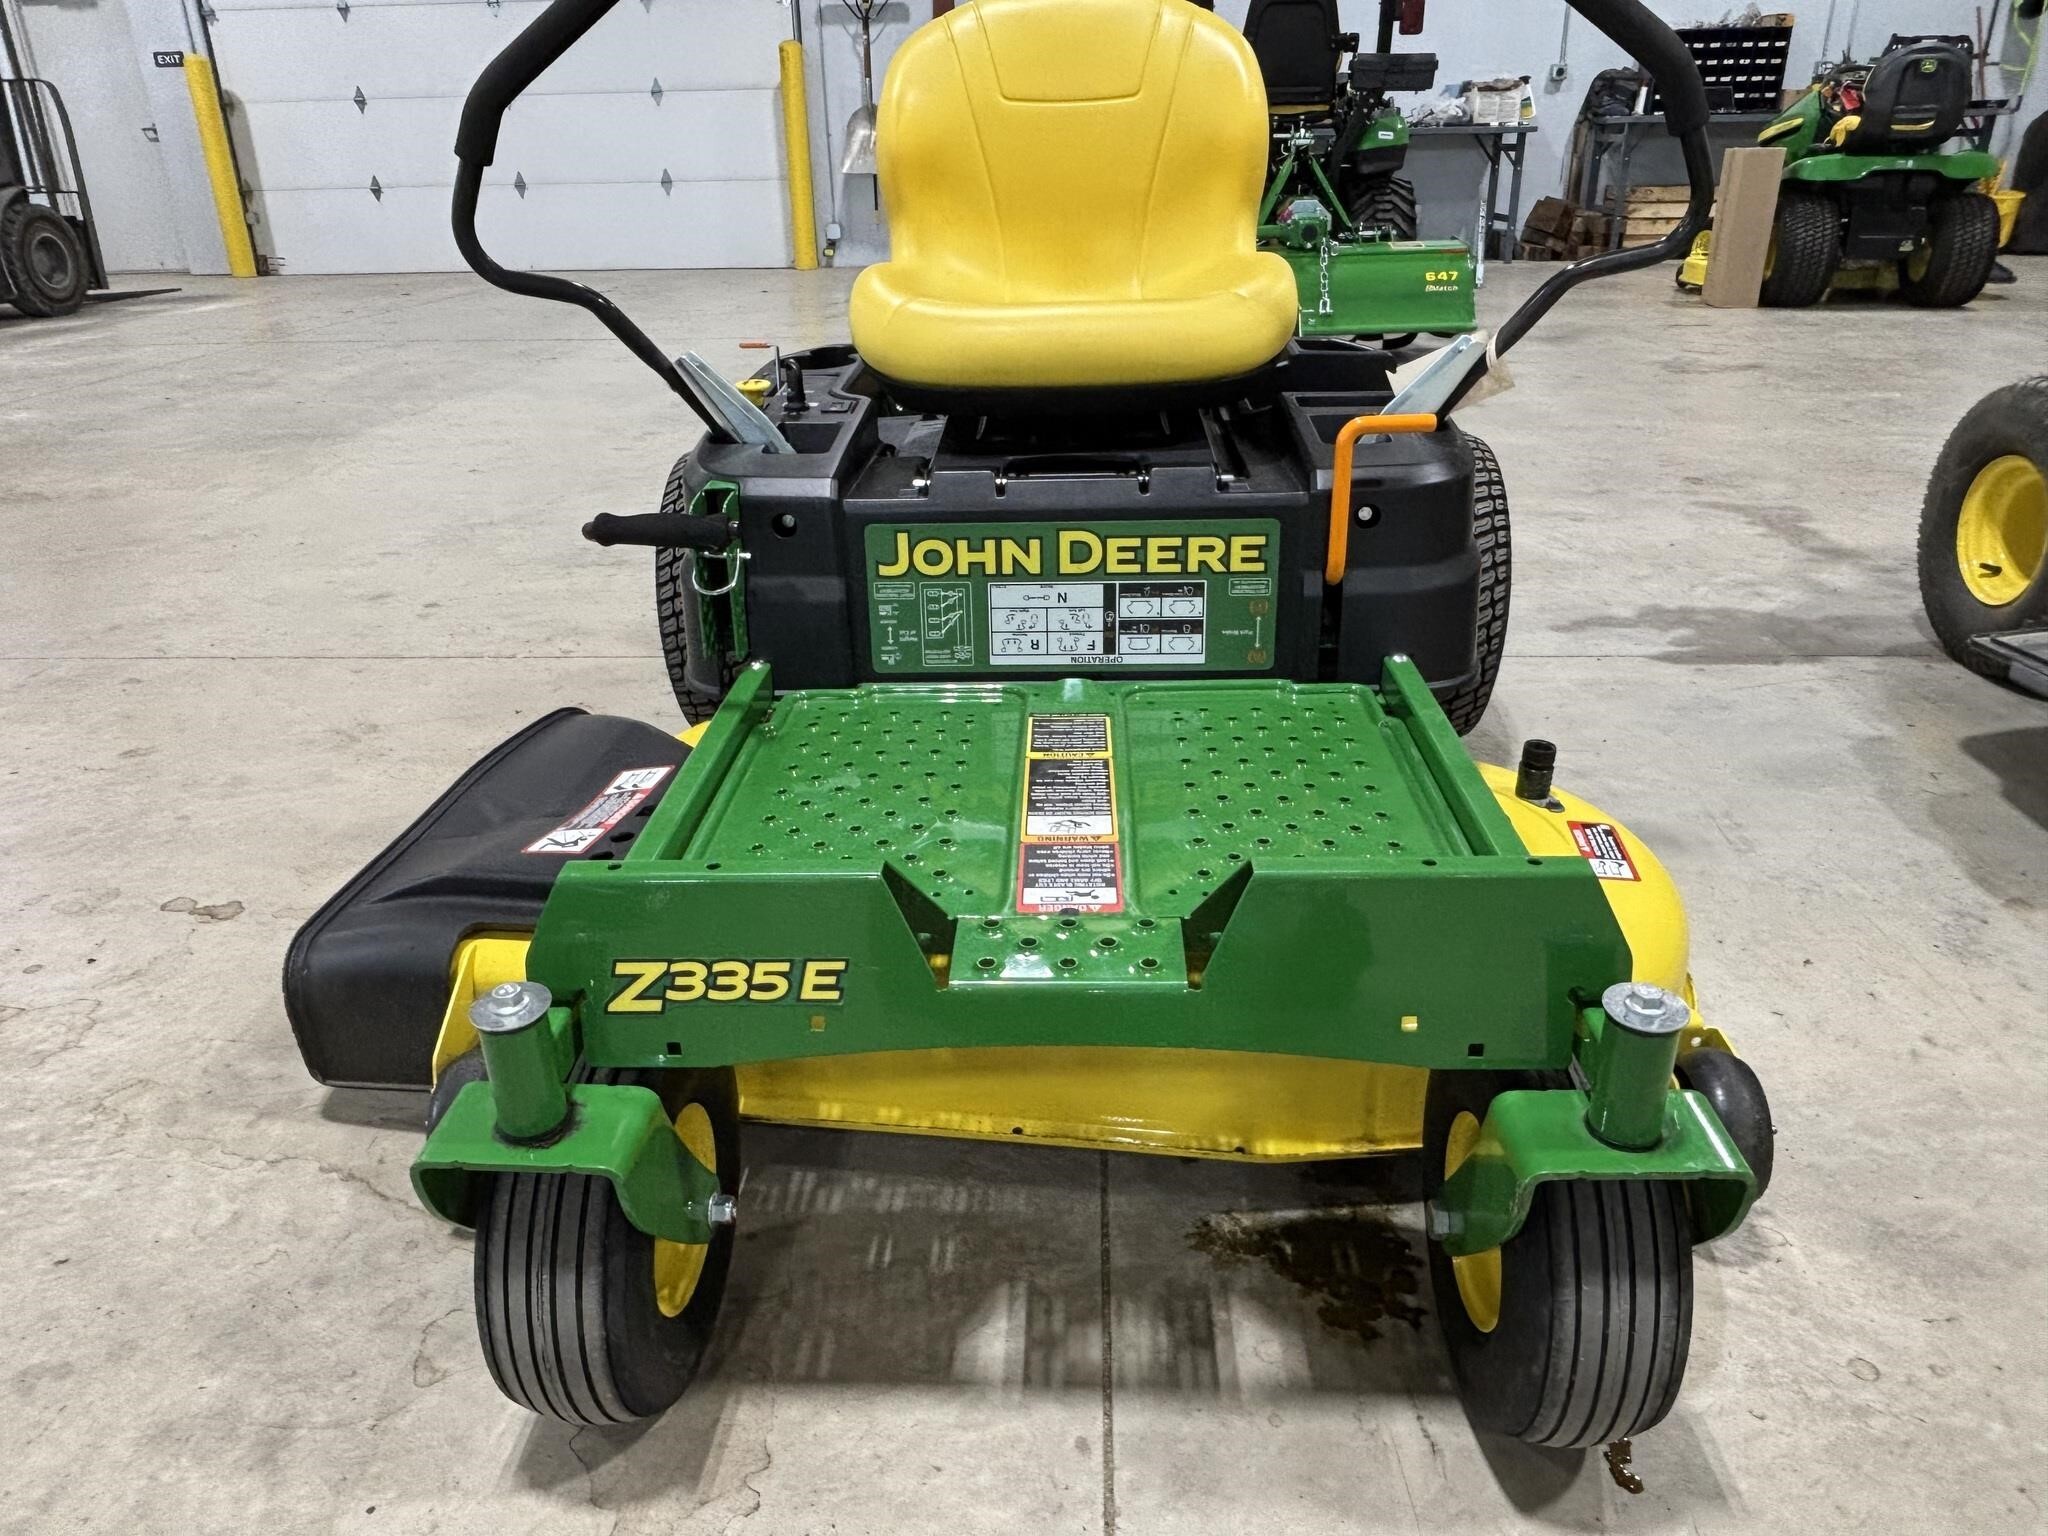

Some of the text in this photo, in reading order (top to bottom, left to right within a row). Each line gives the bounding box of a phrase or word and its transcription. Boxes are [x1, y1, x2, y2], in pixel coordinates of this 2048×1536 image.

[157, 54, 180, 64] EXIT
[1425, 271, 1458, 281] 647
[876, 529, 1267, 577] JOHN DEERE
[1057, 592, 1067, 603] N
[1031, 640, 1039, 650] R
[1087, 640, 1095, 650] F
[1071, 656, 1123, 664] OPERATION
[606, 960, 848, 1013] Z335 E
